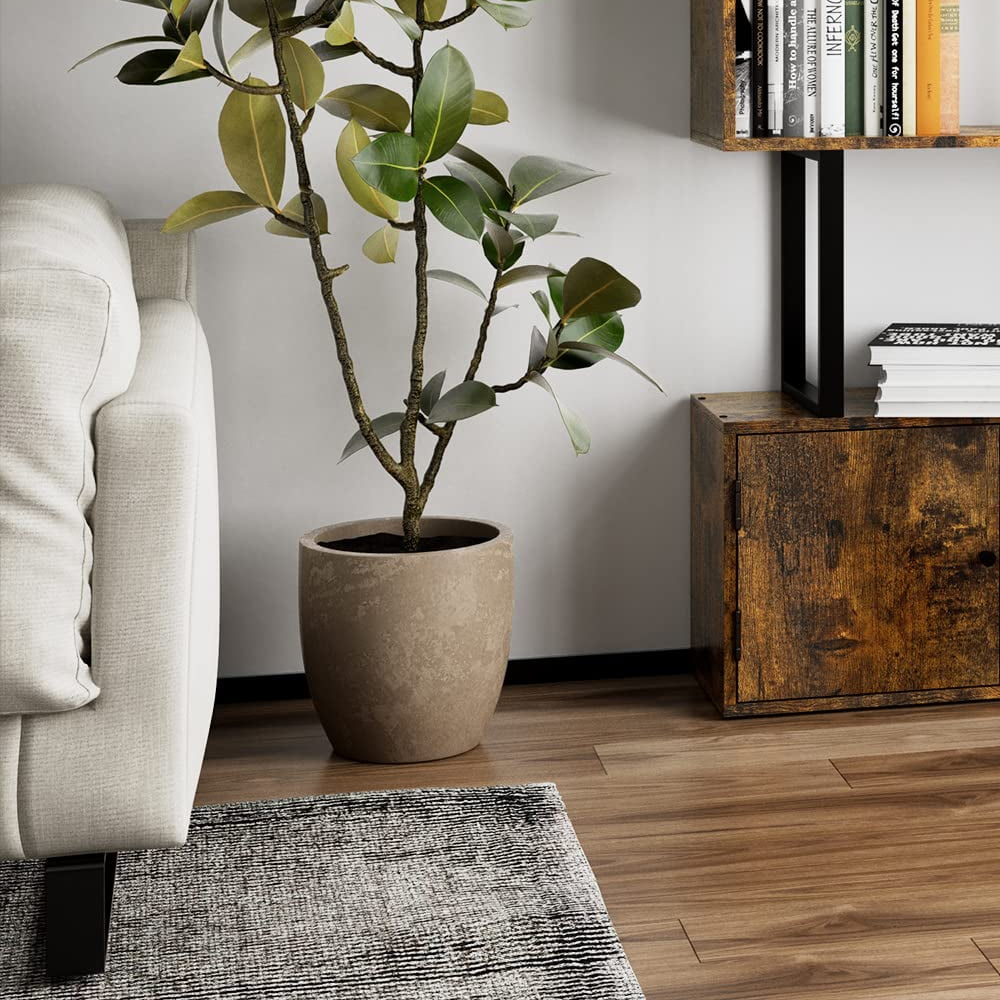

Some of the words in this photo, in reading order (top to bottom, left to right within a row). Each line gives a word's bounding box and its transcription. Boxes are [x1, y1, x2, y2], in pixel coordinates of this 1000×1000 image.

[807, 8, 816, 22] THE
[891, 10, 899, 32] Death
[788, 8, 797, 47] handle
[807, 22, 816, 56] ALLURE
[891, 32, 899, 46] Get
[788, 49, 797, 60] to
[807, 56, 816, 67] OF
[891, 49, 899, 63] one
[788, 63, 797, 89] How
[891, 66, 899, 79] for
[807, 68, 816, 97] WOMEN
